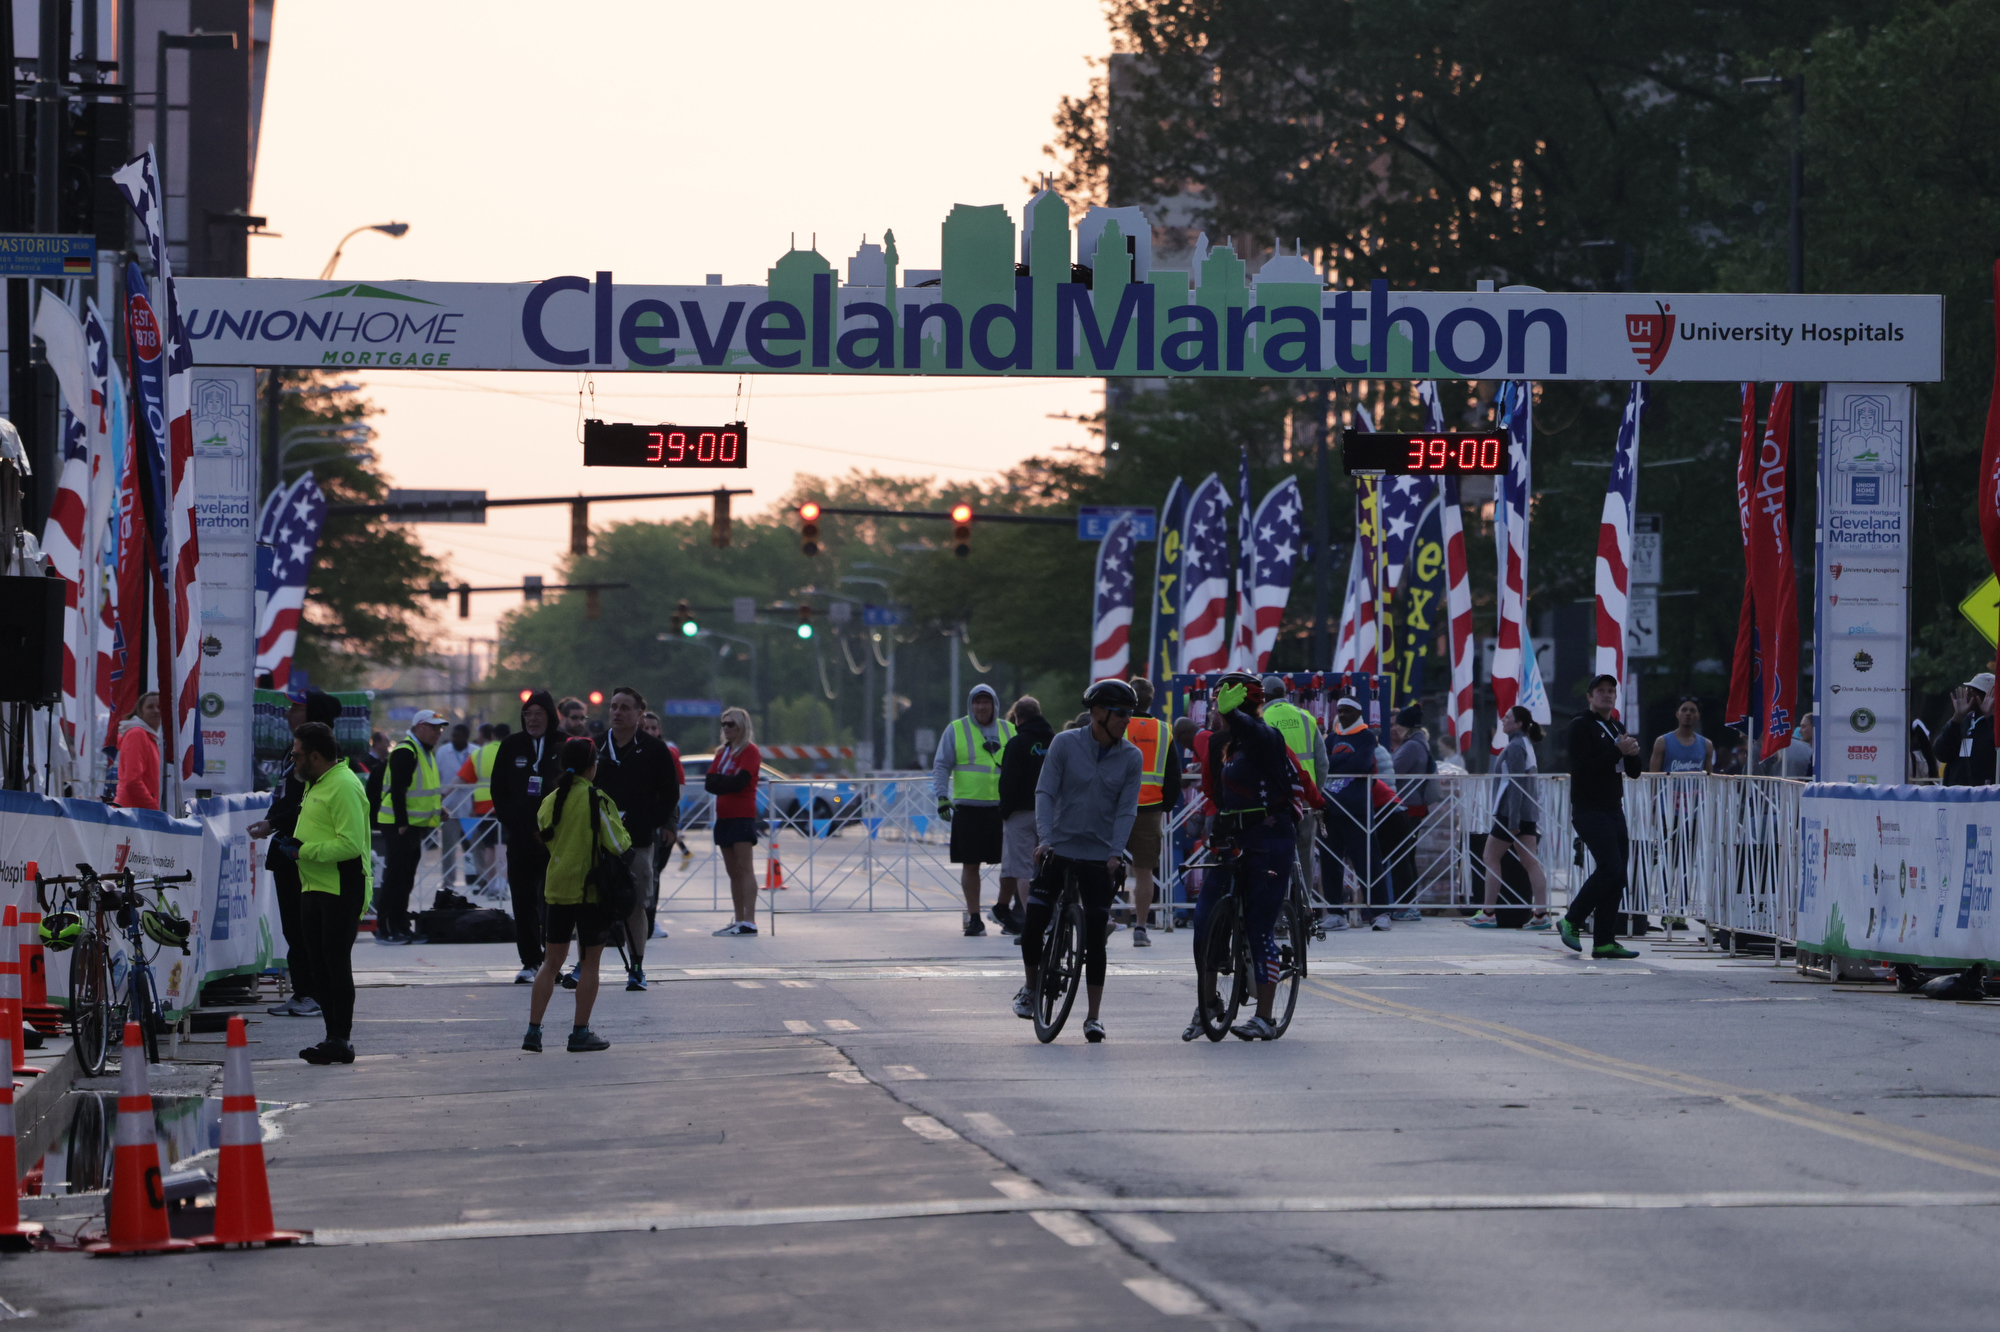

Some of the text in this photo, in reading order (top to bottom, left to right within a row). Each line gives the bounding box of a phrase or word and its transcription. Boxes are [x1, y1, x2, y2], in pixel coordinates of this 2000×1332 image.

[522, 271, 1567, 374] Cleveland Marathon
[1680, 323, 1904, 346] University Hospitals
[321, 351, 452, 366] MORTGAGE
[194, 500, 249, 515] eveland
[196, 514, 249, 528] arathon
[1830, 515, 1901, 529] Cleveland
[1830, 529, 1901, 543] Marathon
[1847, 753, 1877, 762] easy
